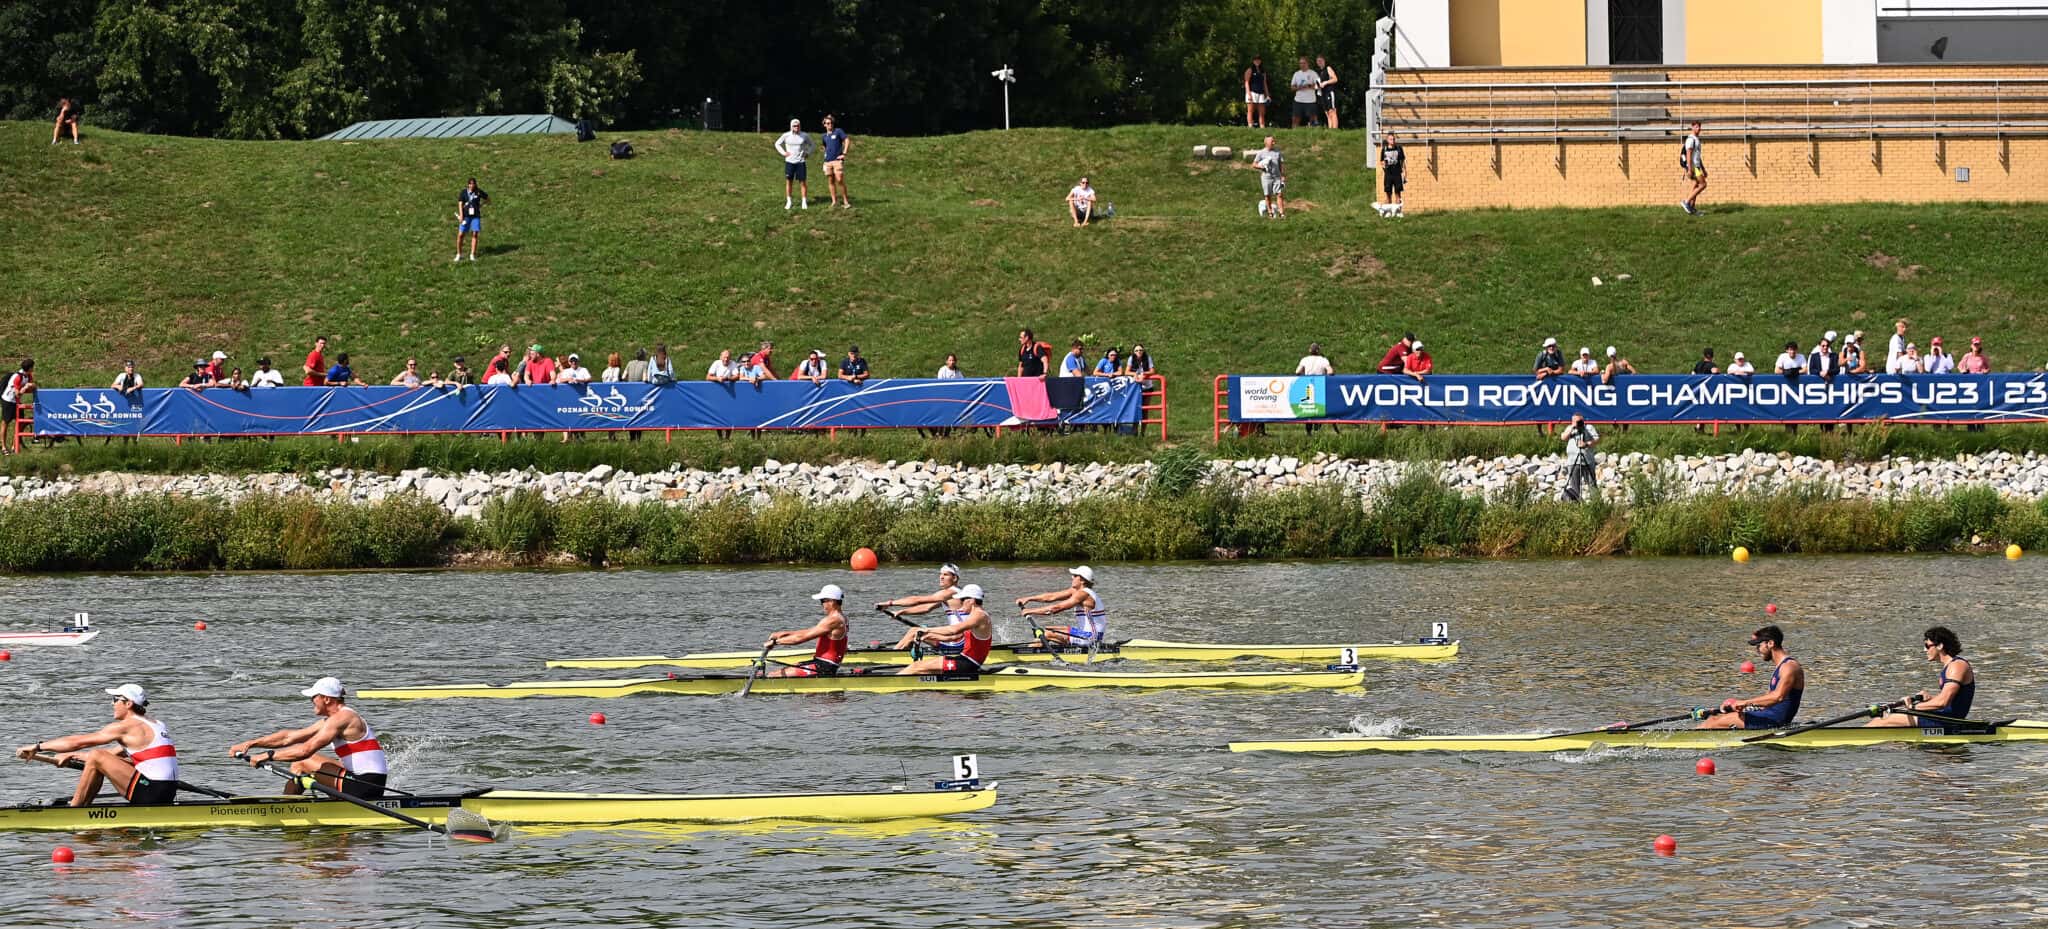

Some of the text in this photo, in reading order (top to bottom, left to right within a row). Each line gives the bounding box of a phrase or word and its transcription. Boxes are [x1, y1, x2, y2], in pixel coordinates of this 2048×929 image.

[1244, 387, 1268, 395] world
[1340, 384, 1469, 406] WORLD
[1479, 384, 1617, 406] ROWING
[1627, 382, 1903, 405] CHAMPIONSHIPS
[1911, 382, 1979, 404] U23
[2004, 381, 2047, 403] 23
[1249, 394, 1277, 402] rowing
[1437, 623, 1444, 637] 2
[1345, 648, 1354, 664] 3
[960, 755, 972, 778] 5
[88, 807, 117, 819] wilo
[210, 804, 309, 817] Pioneering for You
